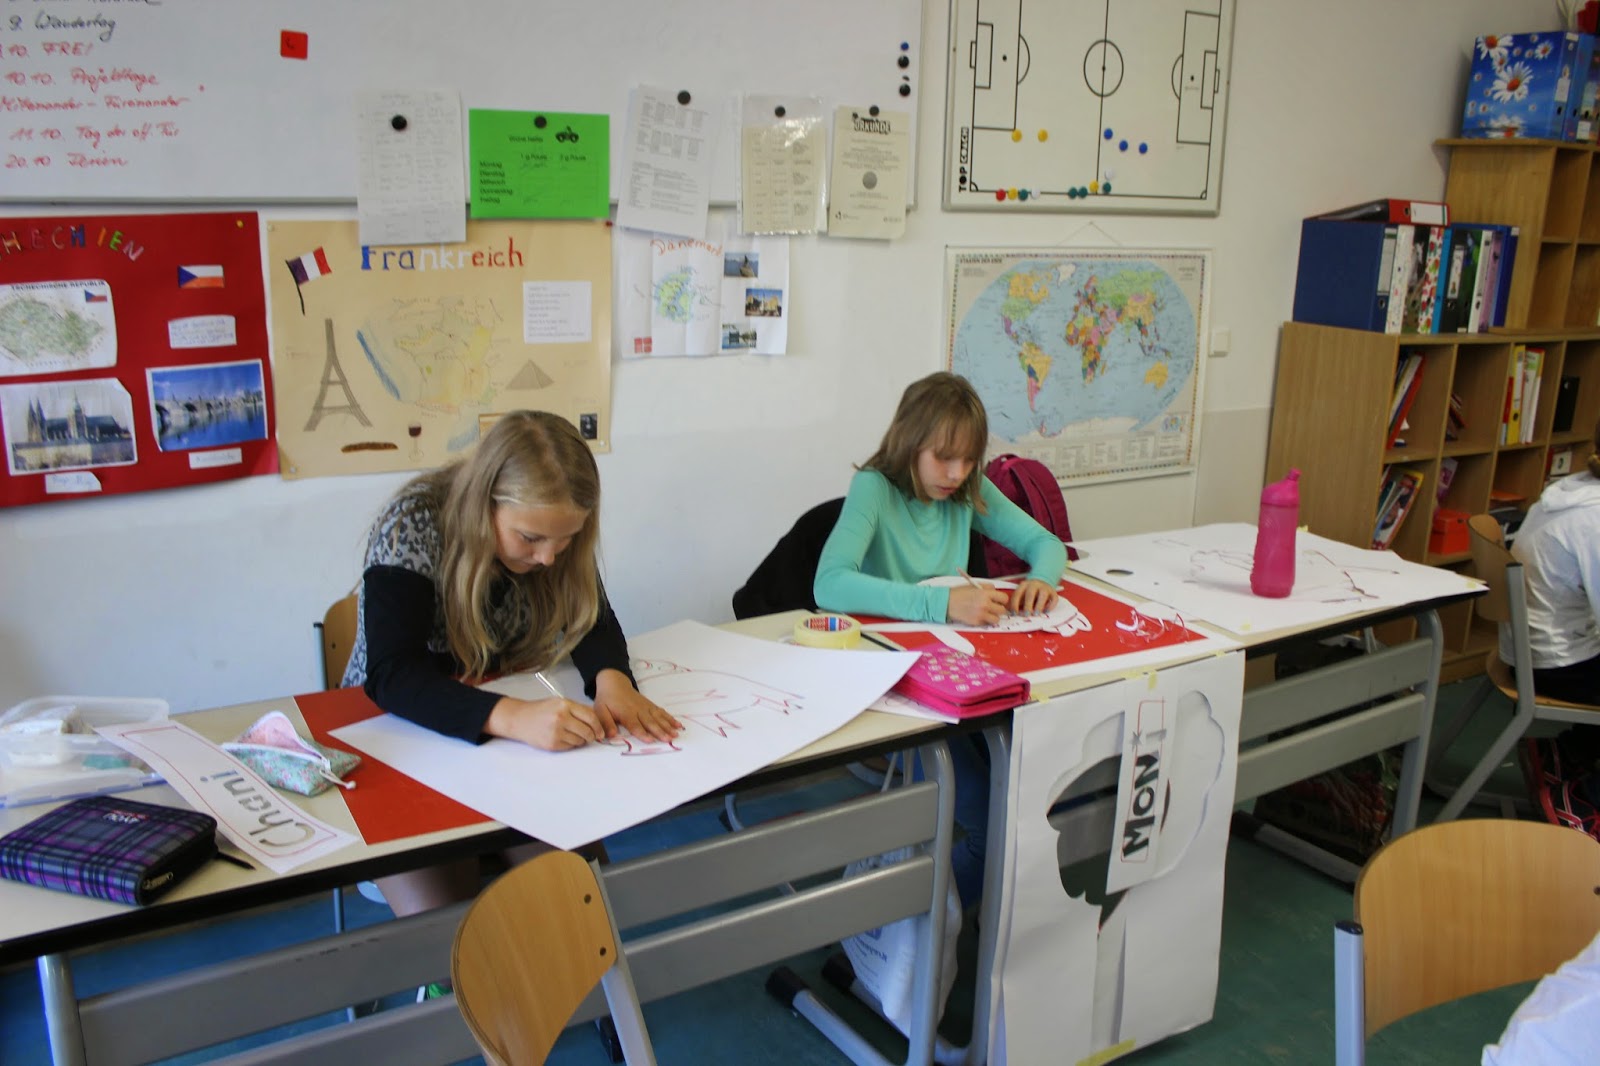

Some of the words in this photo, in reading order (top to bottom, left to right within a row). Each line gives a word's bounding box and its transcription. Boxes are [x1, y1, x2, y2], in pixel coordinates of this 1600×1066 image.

[76, 125, 101, 149] Tag
[958, 166, 969, 193] TOP
[0, 224, 144, 262] HECHIEN
[361, 237, 524, 271] Frankreich
[200, 769, 315, 848] Chani
